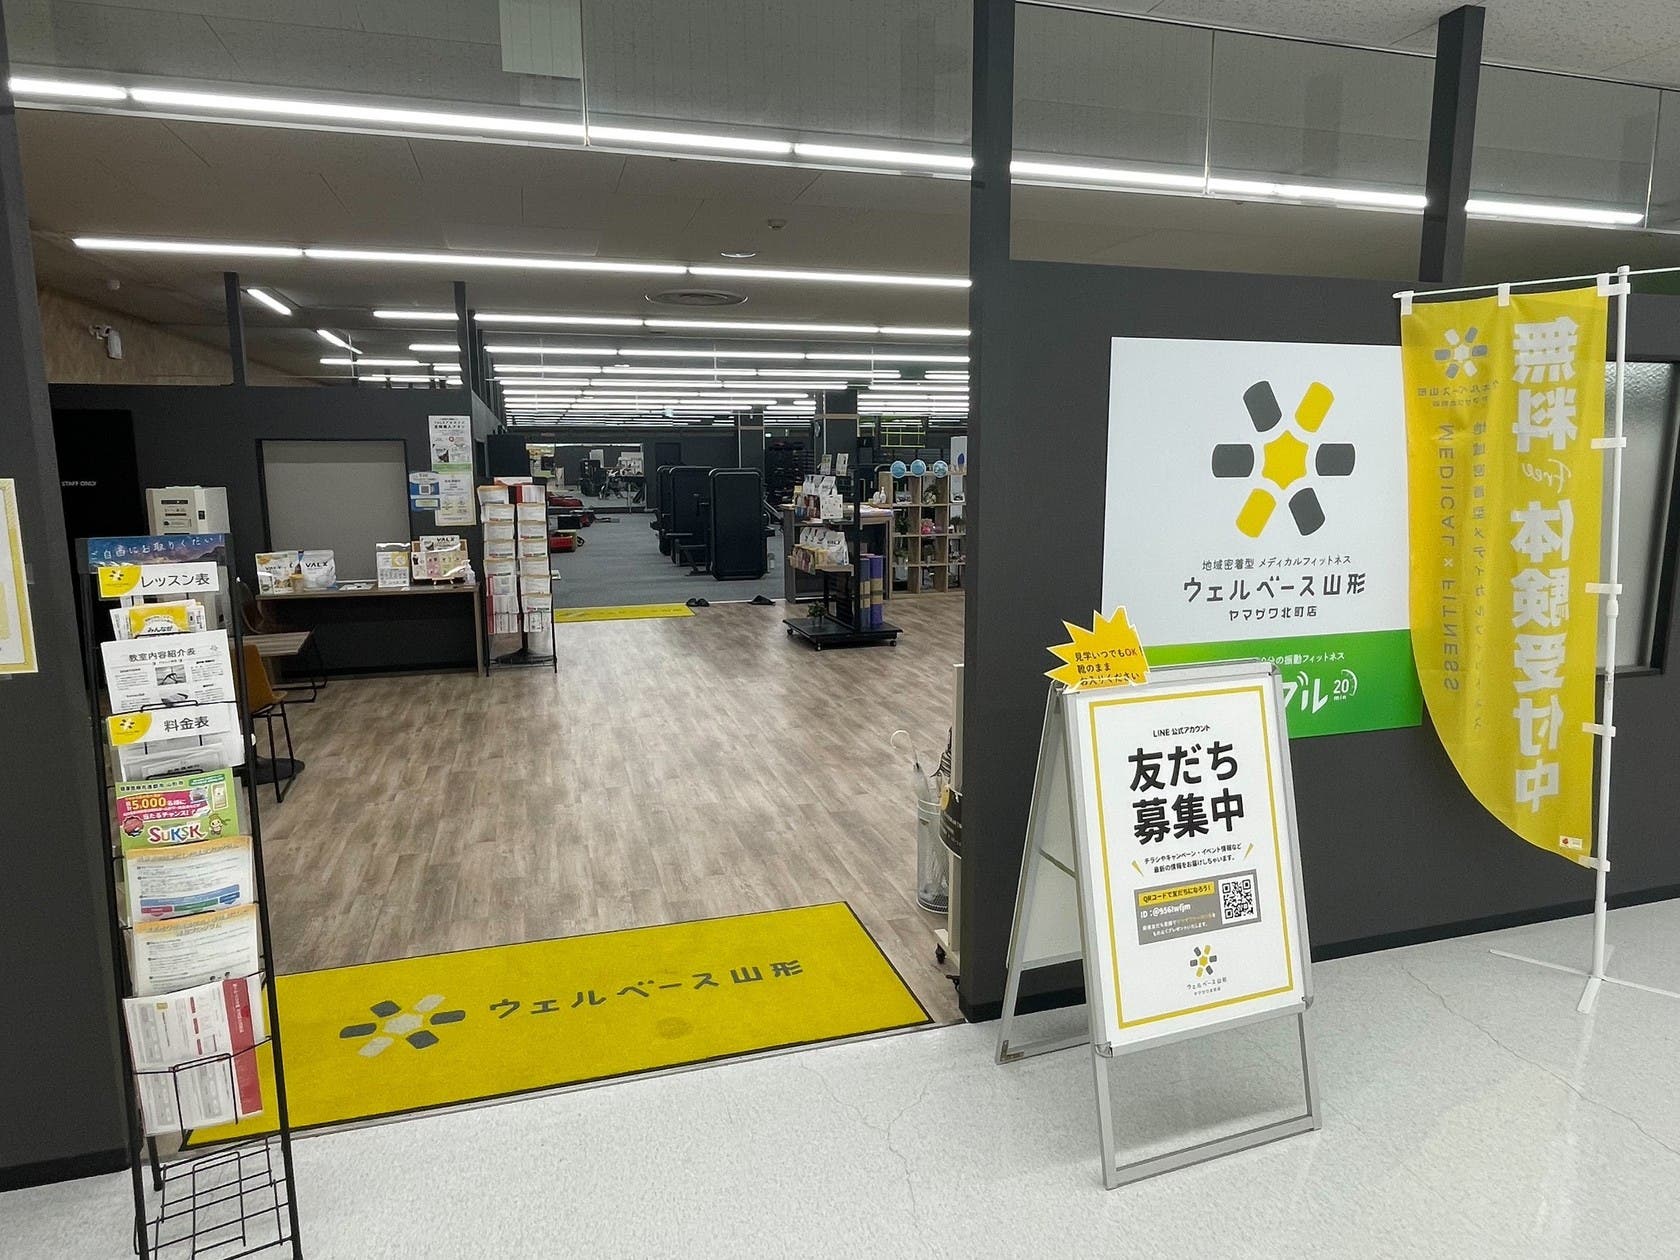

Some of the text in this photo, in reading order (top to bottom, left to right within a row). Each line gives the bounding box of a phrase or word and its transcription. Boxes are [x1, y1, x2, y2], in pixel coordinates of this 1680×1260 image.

[1202, 555, 1351, 571] 地域密着型 メディカルフィットネス
[141, 573, 210, 588] レッスン表
[1183, 573, 1366, 602] ウェルベース山形
[1229, 606, 1317, 621] ヤマザワ北町店
[129, 647, 196, 662] 教室内容紹介表
[1333, 679, 1350, 694] 20
[164, 716, 209, 732] 料金表
[1153, 725, 1210, 737] LINE 公式アカウント
[1128, 741, 1238, 792] 友だち
[1132, 788, 1244, 845] 募集中
[489, 959, 803, 1019] ウェルベース山形
